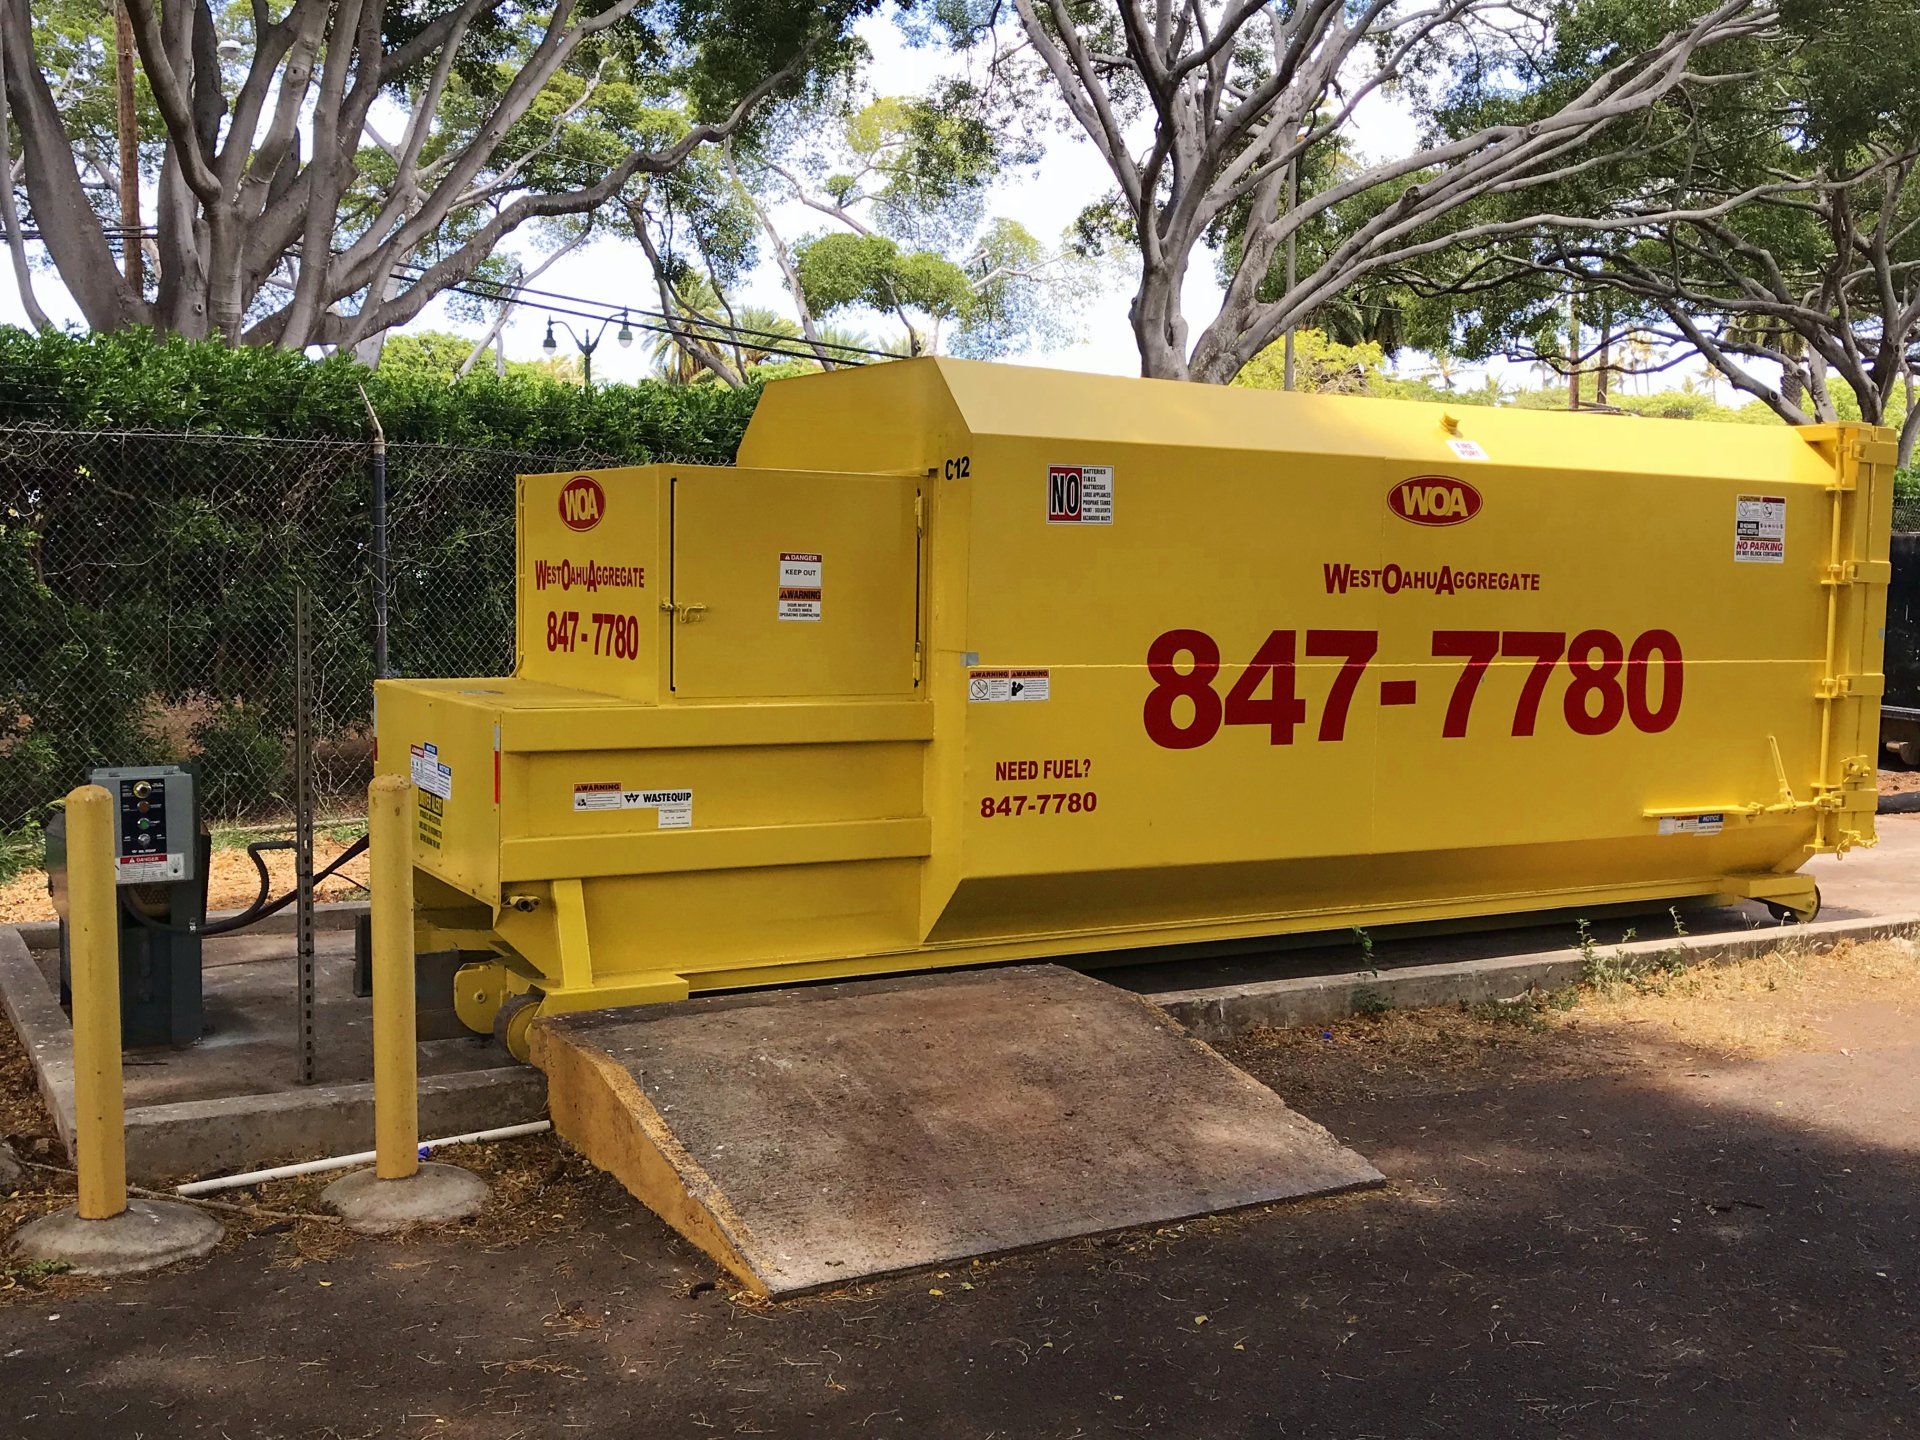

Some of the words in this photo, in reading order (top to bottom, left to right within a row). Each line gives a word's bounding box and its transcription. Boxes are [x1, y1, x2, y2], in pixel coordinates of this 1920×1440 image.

[945, 456, 970, 480] C12
[1051, 473, 1080, 516] NO
[1402, 486, 1468, 516] WOA
[564, 488, 599, 521] WOA
[1737, 541, 1748, 550] NO
[1749, 541, 1783, 551] PARKING
[791, 554, 818, 562] DANGER
[785, 568, 802, 576] KEEP
[787, 590, 821, 600] WARNING
[1016, 670, 1048, 678] WARNING
[1143, 629, 1684, 749] 847-7780
[996, 761, 1038, 781] NEED
[1043, 759, 1091, 779] FUEL?
[581, 784, 620, 792] WARNING
[643, 792, 692, 803] WASTEQUIP
[980, 791, 1097, 818] 847-7780
